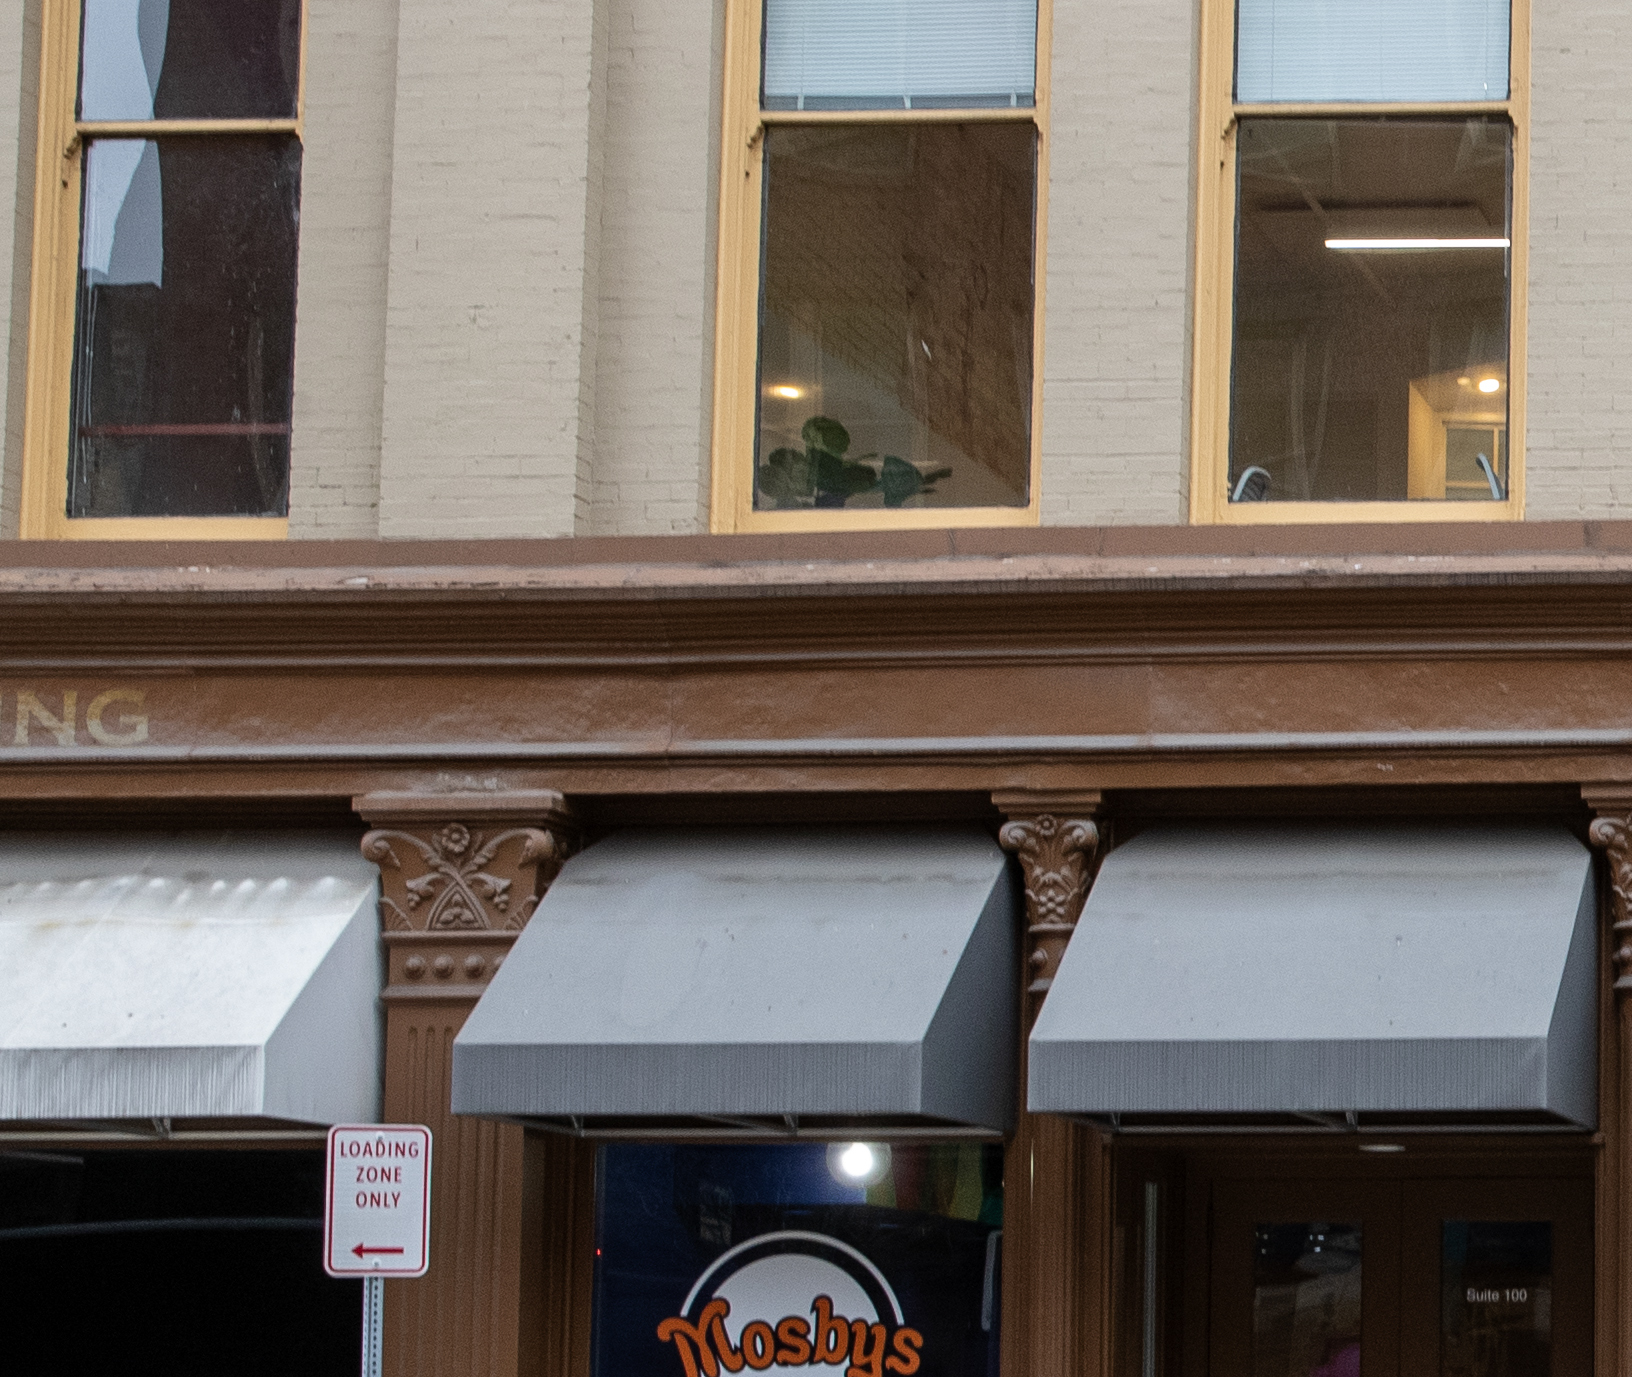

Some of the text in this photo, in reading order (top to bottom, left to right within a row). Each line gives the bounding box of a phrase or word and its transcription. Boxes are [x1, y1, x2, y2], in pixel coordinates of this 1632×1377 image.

[14, 689, 150, 748] NG
[340, 1140, 419, 1159] LOADING
[356, 1166, 402, 1184] ZONE
[356, 1191, 401, 1208] ONLY
[1505, 1287, 1529, 1303] 100
